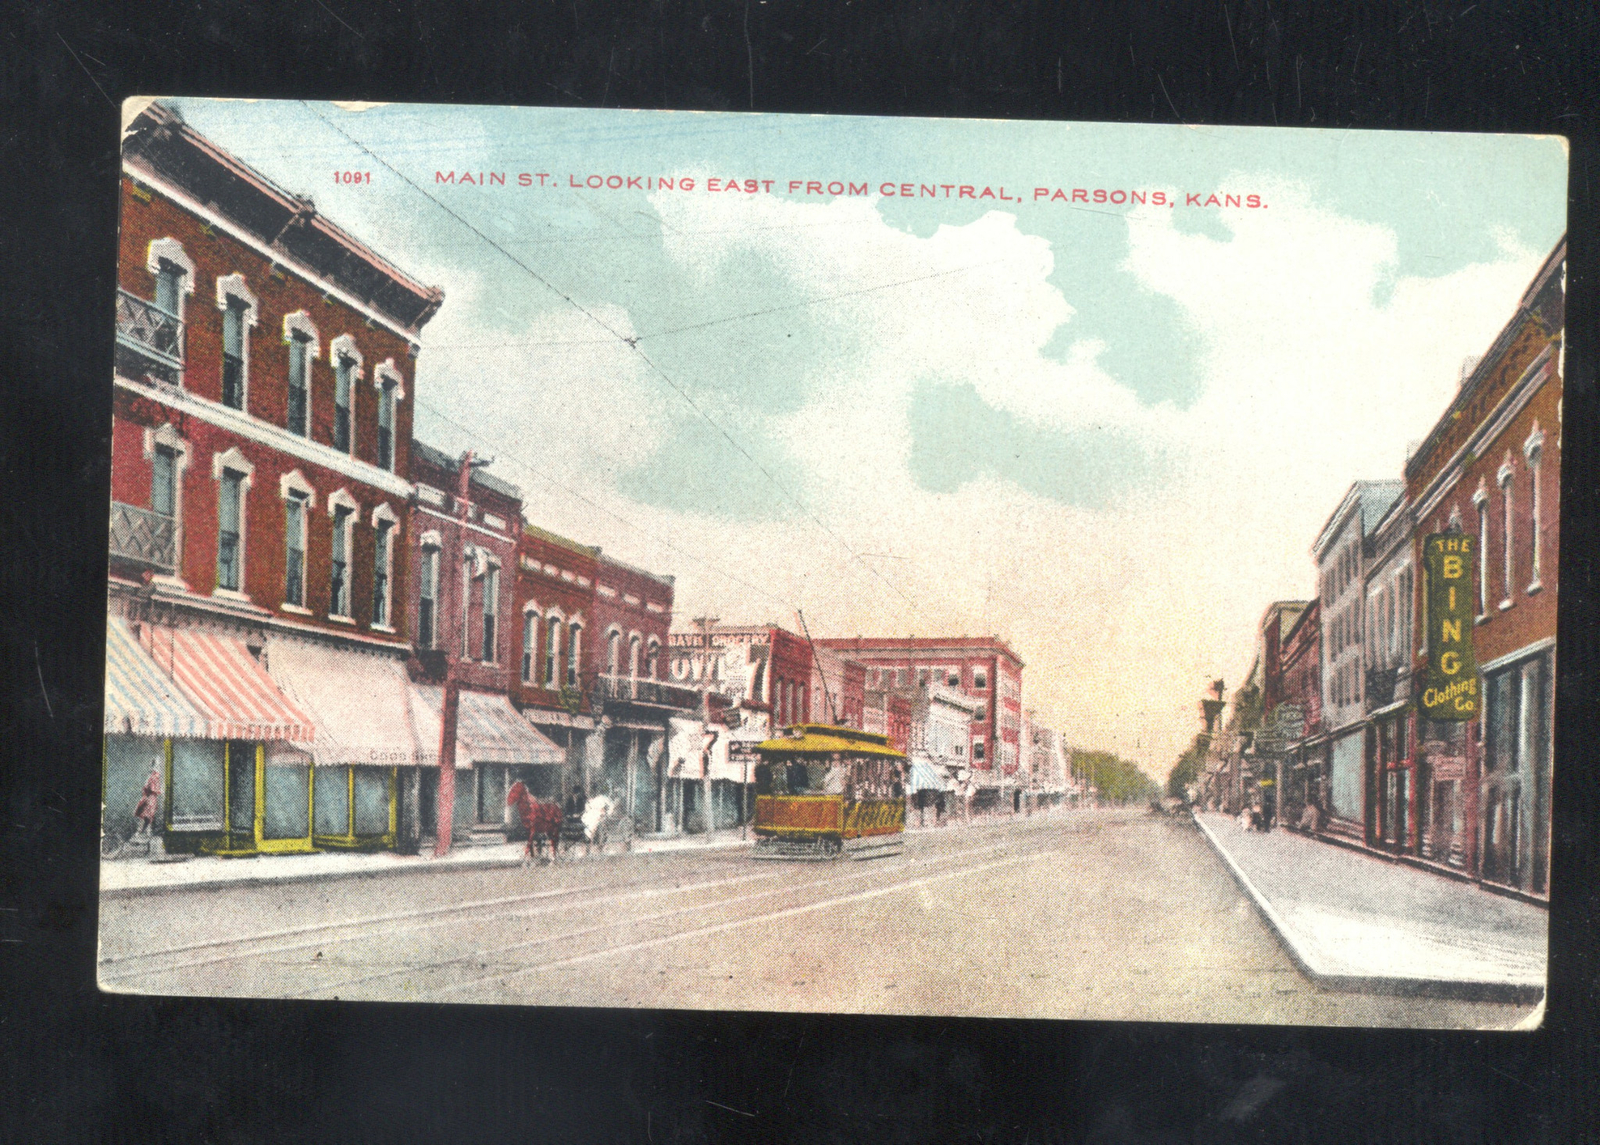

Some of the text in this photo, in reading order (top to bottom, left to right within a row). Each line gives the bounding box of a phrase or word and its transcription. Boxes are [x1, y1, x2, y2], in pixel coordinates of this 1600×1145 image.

[1436, 539, 1471, 552] THE
[1441, 555, 1464, 675] BING
[1423, 678, 1477, 708] Clothing
[1454, 697, 1475, 711] Co
